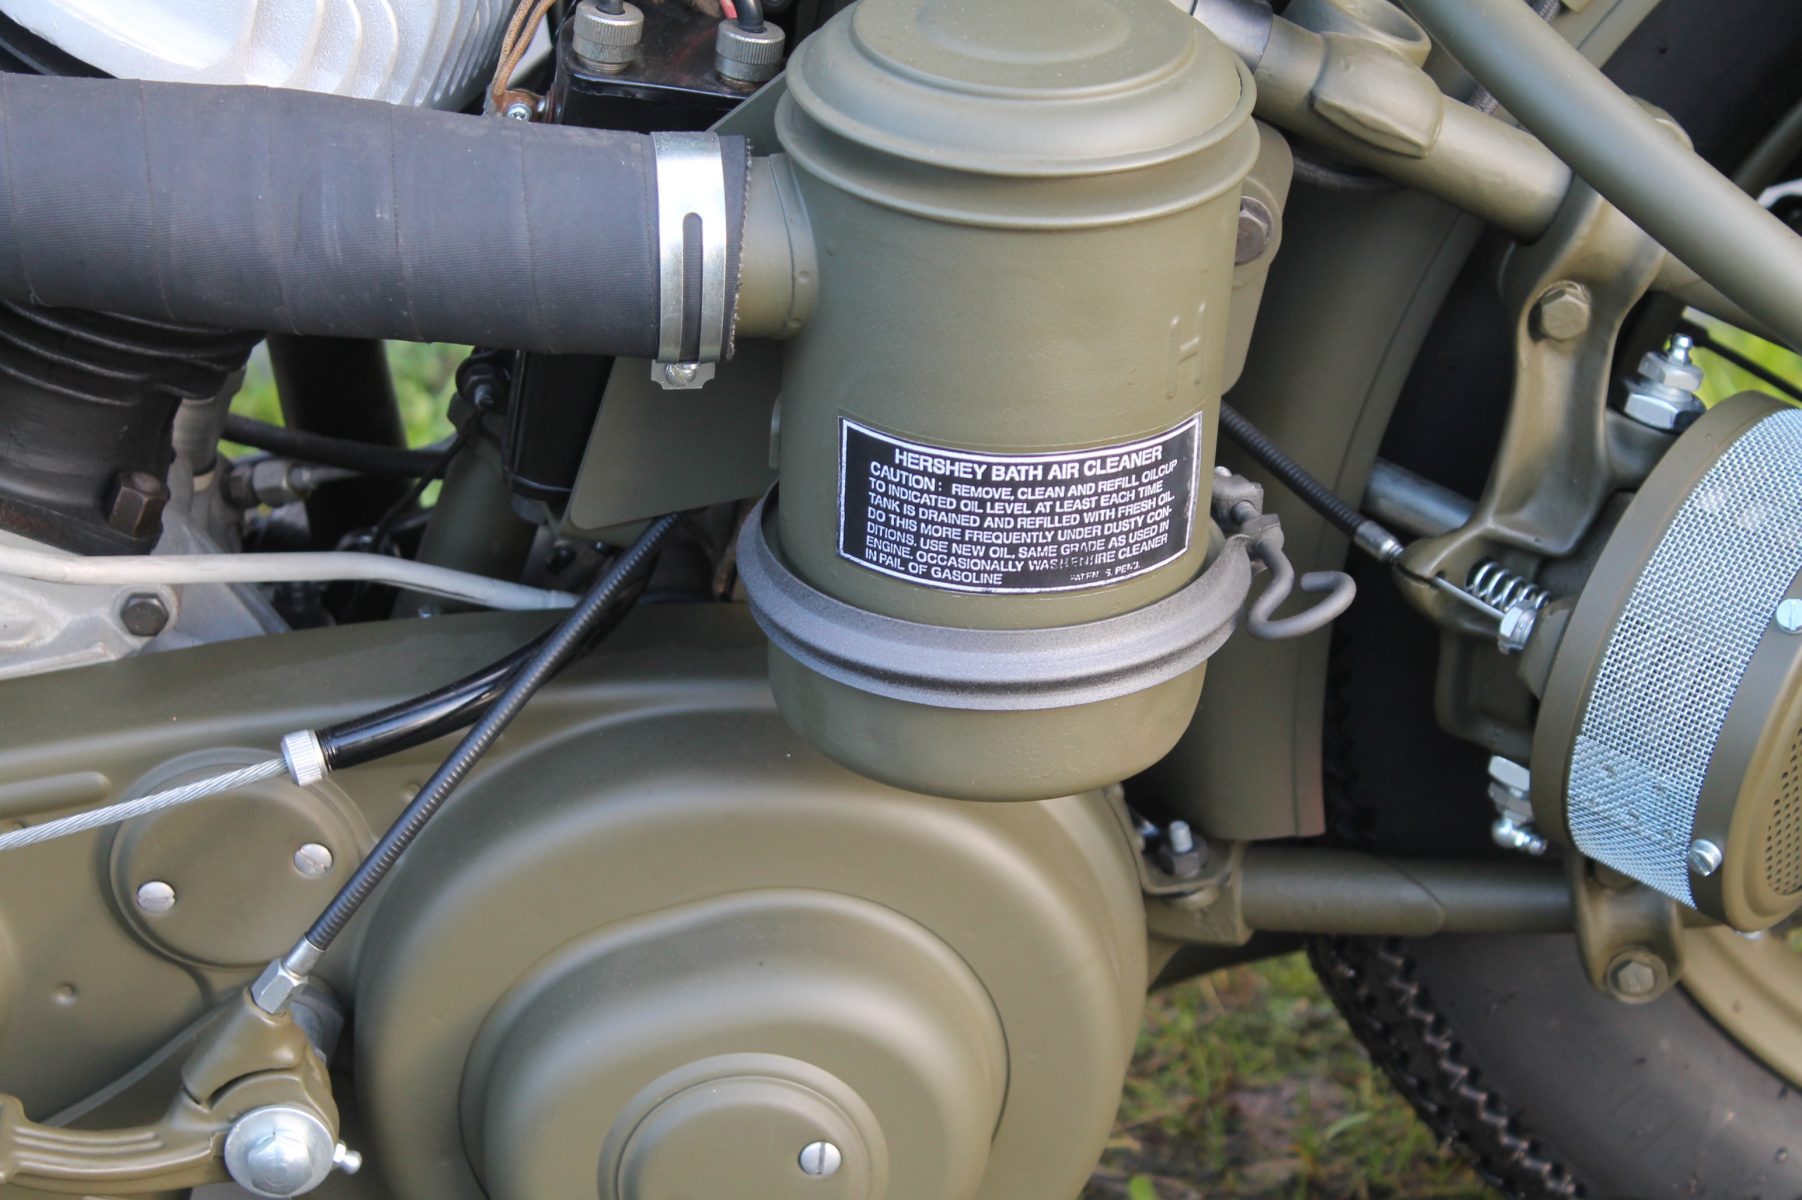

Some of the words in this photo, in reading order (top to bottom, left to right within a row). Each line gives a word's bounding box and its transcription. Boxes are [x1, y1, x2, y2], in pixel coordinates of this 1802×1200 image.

[895, 448, 987, 480] HERSHEY
[991, 464, 1043, 481] BATH
[1047, 462, 1080, 480] AIR
[1083, 445, 1163, 476] CLEANER
[869, 477, 886, 493] TO
[889, 483, 957, 510] INDICATED
[960, 499, 984, 513] OIL
[986, 501, 1032, 514] LEVEL
[1034, 501, 1053, 514] AT
[1055, 496, 1099, 513] LEAST
[1100, 489, 1135, 507] EACH
[1137, 480, 1163, 498] TIME
[952, 483, 1014, 500] REMOVE,
[1017, 486, 1065, 500] CLEAN
[1067, 482, 1096, 497] AND
[1098, 474, 1140, 493] REFILL
[867, 506, 886, 522] DO
[888, 514, 917, 532] THIS
[920, 522, 962, 540] MORE
[965, 529, 1055, 544] FREQUENTLY
[1057, 525, 1102, 541] UNDER
[1103, 515, 1145, 535] DUSTY
[868, 491, 900, 513] TANK
[903, 503, 916, 517] IS
[919, 507, 980, 527] DRAINED
[983, 516, 1014, 529] AND
[1017, 514, 1080, 529] REFILLED
[1083, 508, 1116, 524] WITH
[1117, 497, 1156, 518] FRESH
[916, 550, 1024, 572] OCCASIONALLY
[1118, 533, 1168, 560] CLEANER
[920, 537, 949, 553] USE
[952, 543, 985, 557] NEW
[1018, 545, 1058, 558] SAME
[1108, 534, 1126, 549] AS
[1128, 524, 1158, 544] USED
[1159, 519, 1169, 534] IN
[865, 547, 877, 561] IN
[879, 552, 905, 570] PAIL
[908, 562, 928, 575] OF
[931, 566, 1003, 584] GASOLINE
